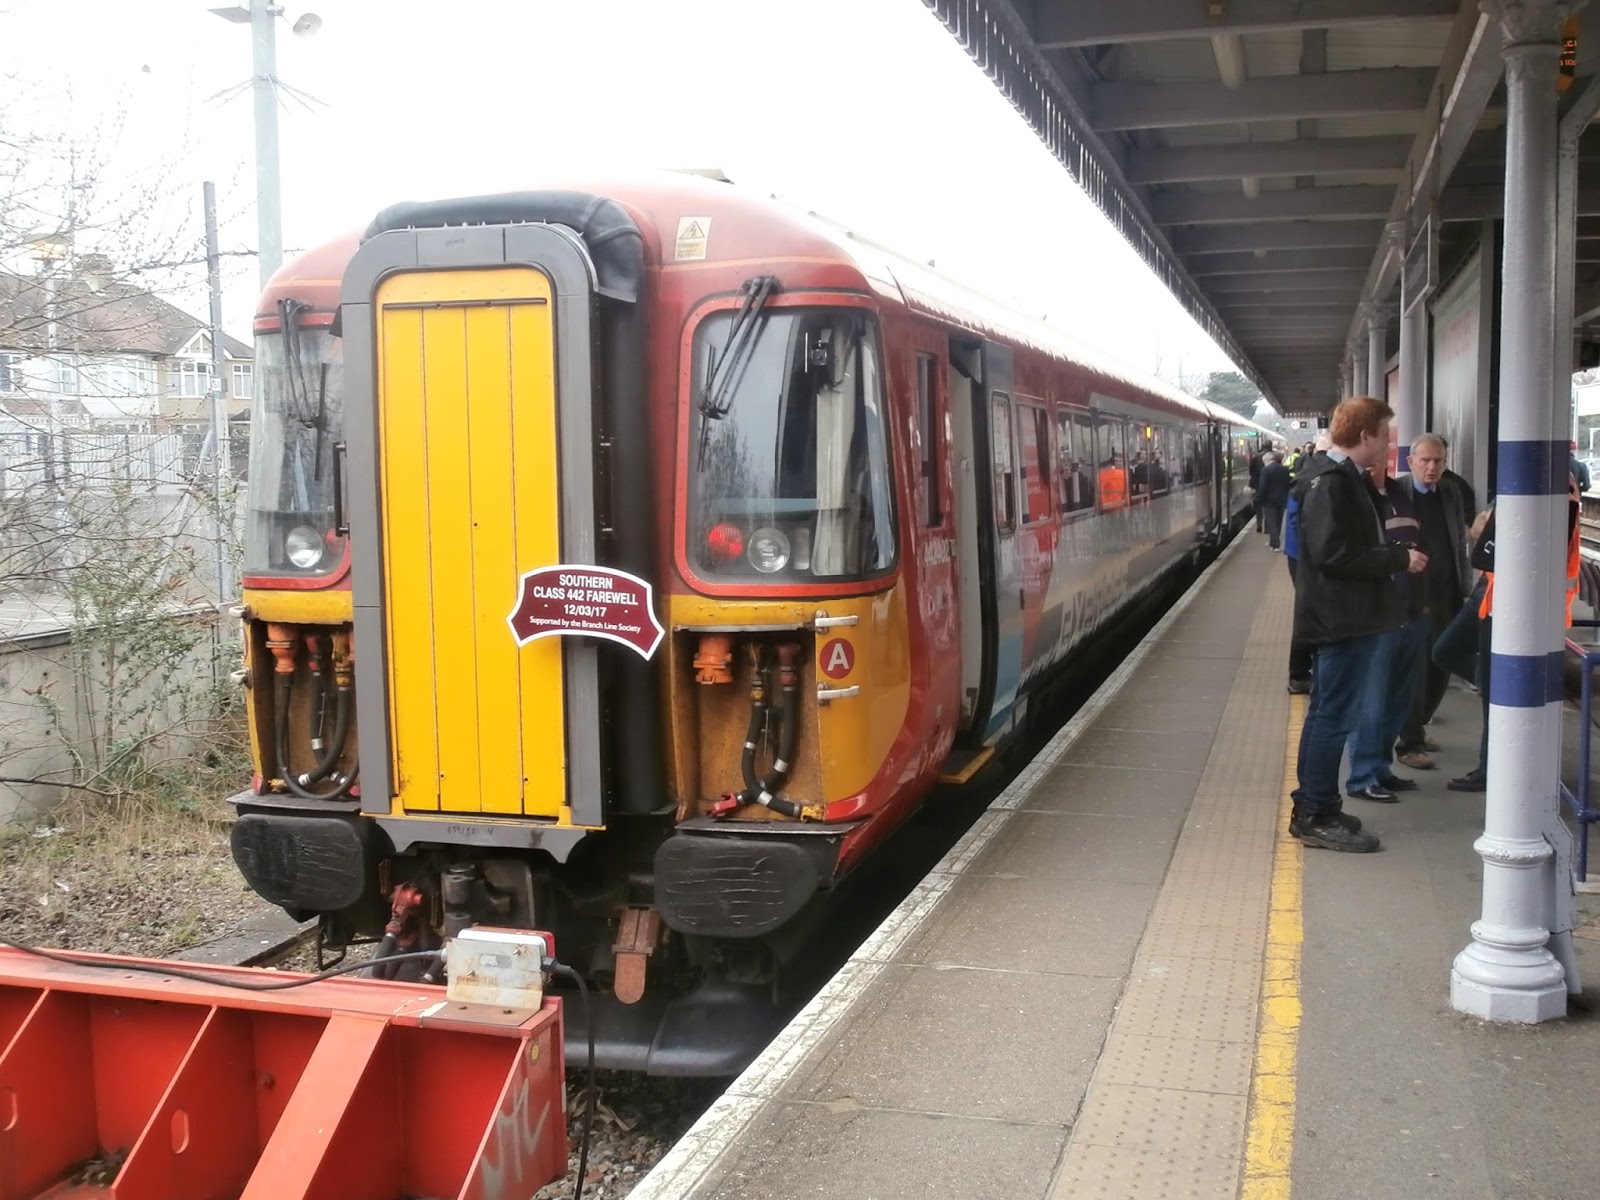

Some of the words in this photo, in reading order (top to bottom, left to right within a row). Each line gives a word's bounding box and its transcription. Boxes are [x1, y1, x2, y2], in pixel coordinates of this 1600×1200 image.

[559, 574, 613, 589] SOUTHERN
[533, 586, 565, 600] CLASS
[567, 588, 585, 601] 442
[586, 590, 639, 605] FAREWELL
[563, 604, 607, 617] 12/03/17
[529, 616, 561, 626] Supported
[561, 618, 570, 627] by
[570, 619, 581, 628] the
[581, 620, 603, 629] Branch
[604, 622, 618, 631] Line
[618, 623, 641, 634] Society
[827, 643, 850, 671] A
